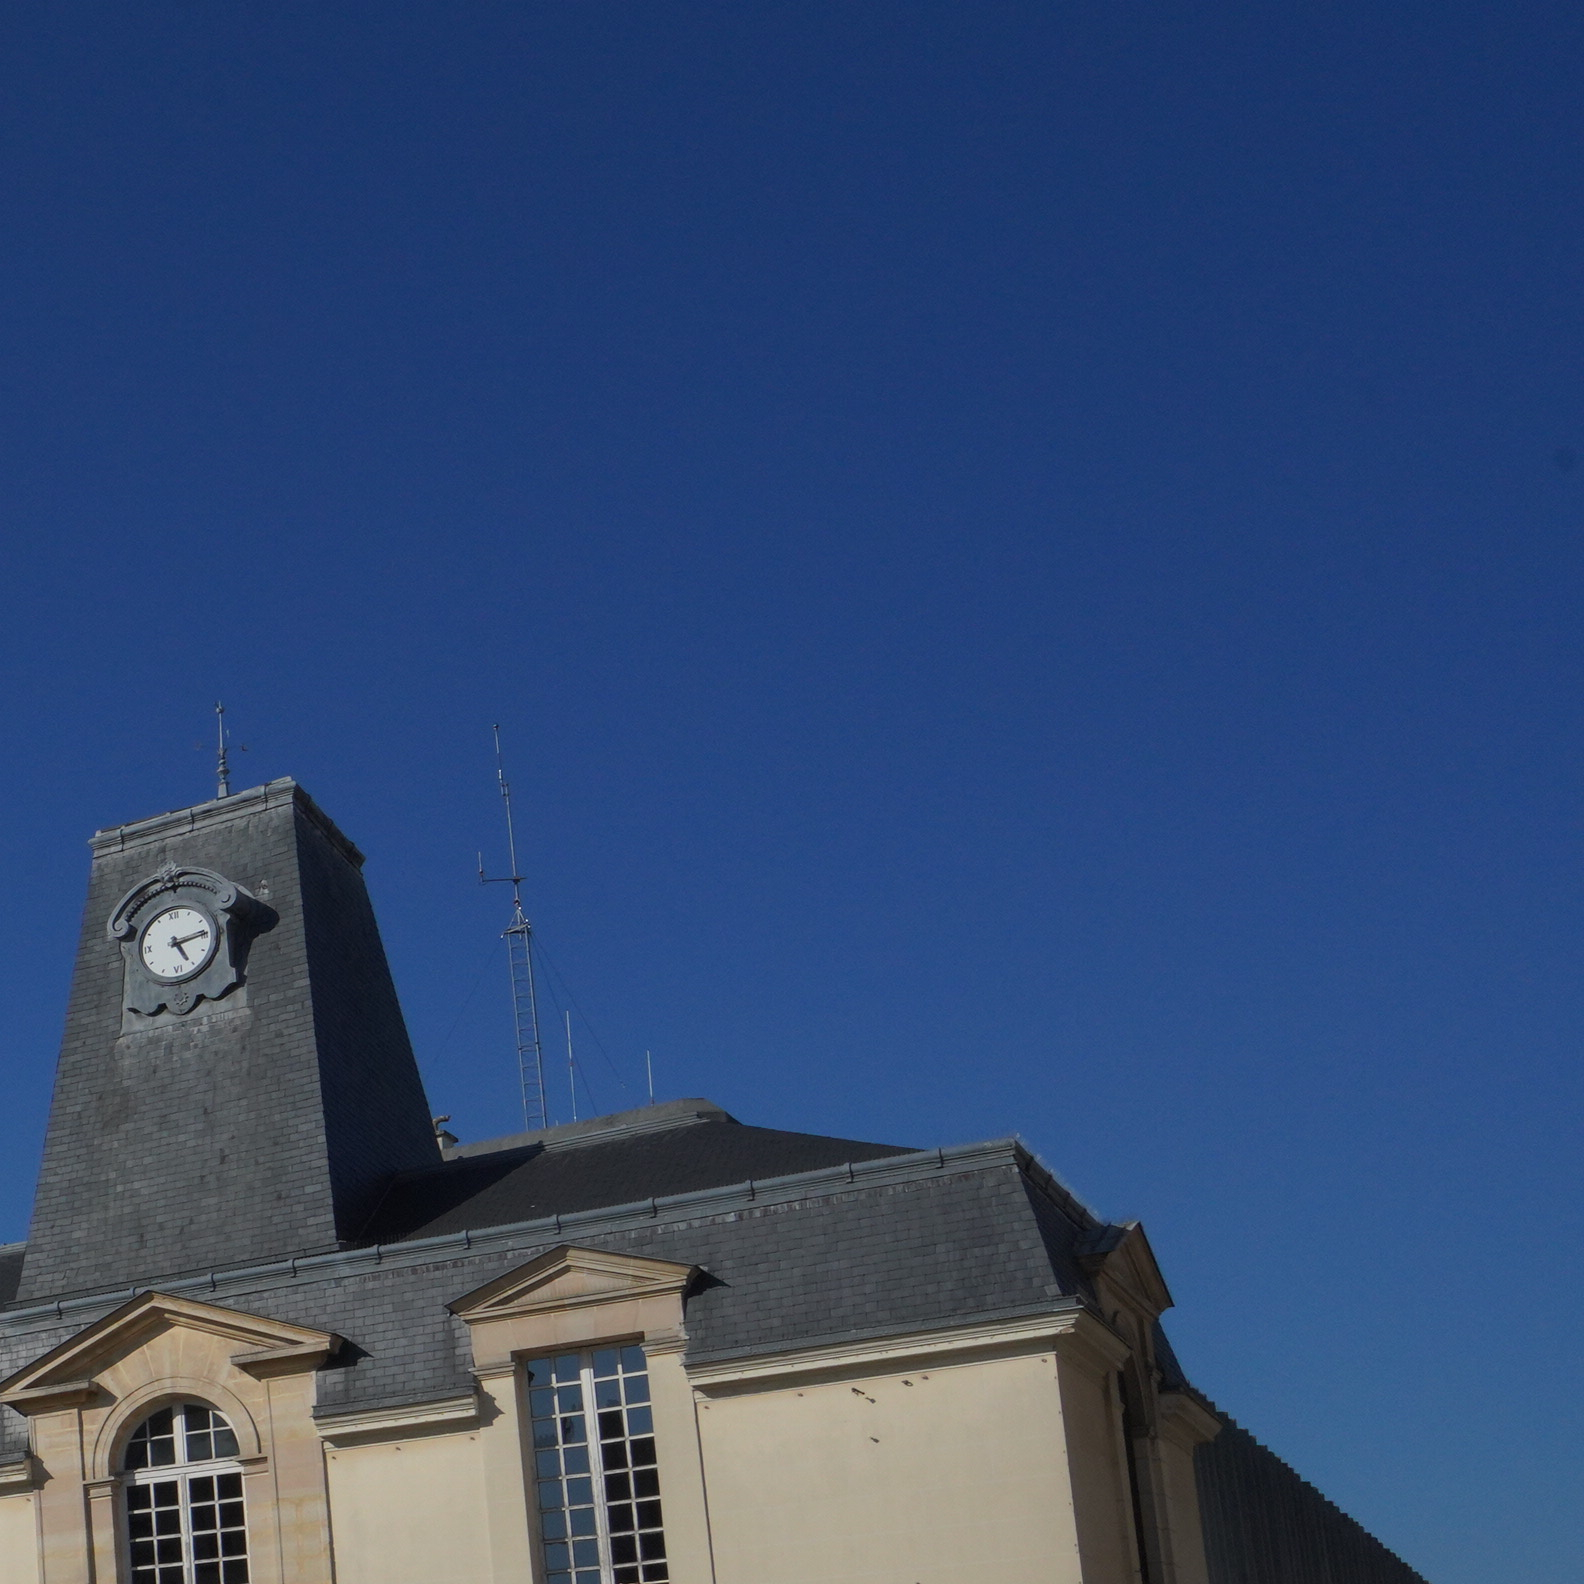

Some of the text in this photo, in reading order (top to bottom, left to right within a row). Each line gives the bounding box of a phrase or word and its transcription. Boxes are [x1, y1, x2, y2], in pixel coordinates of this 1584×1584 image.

[168, 911, 179, 920] XII
[144, 945, 153, 954] IX
[173, 965, 183, 974] VI
